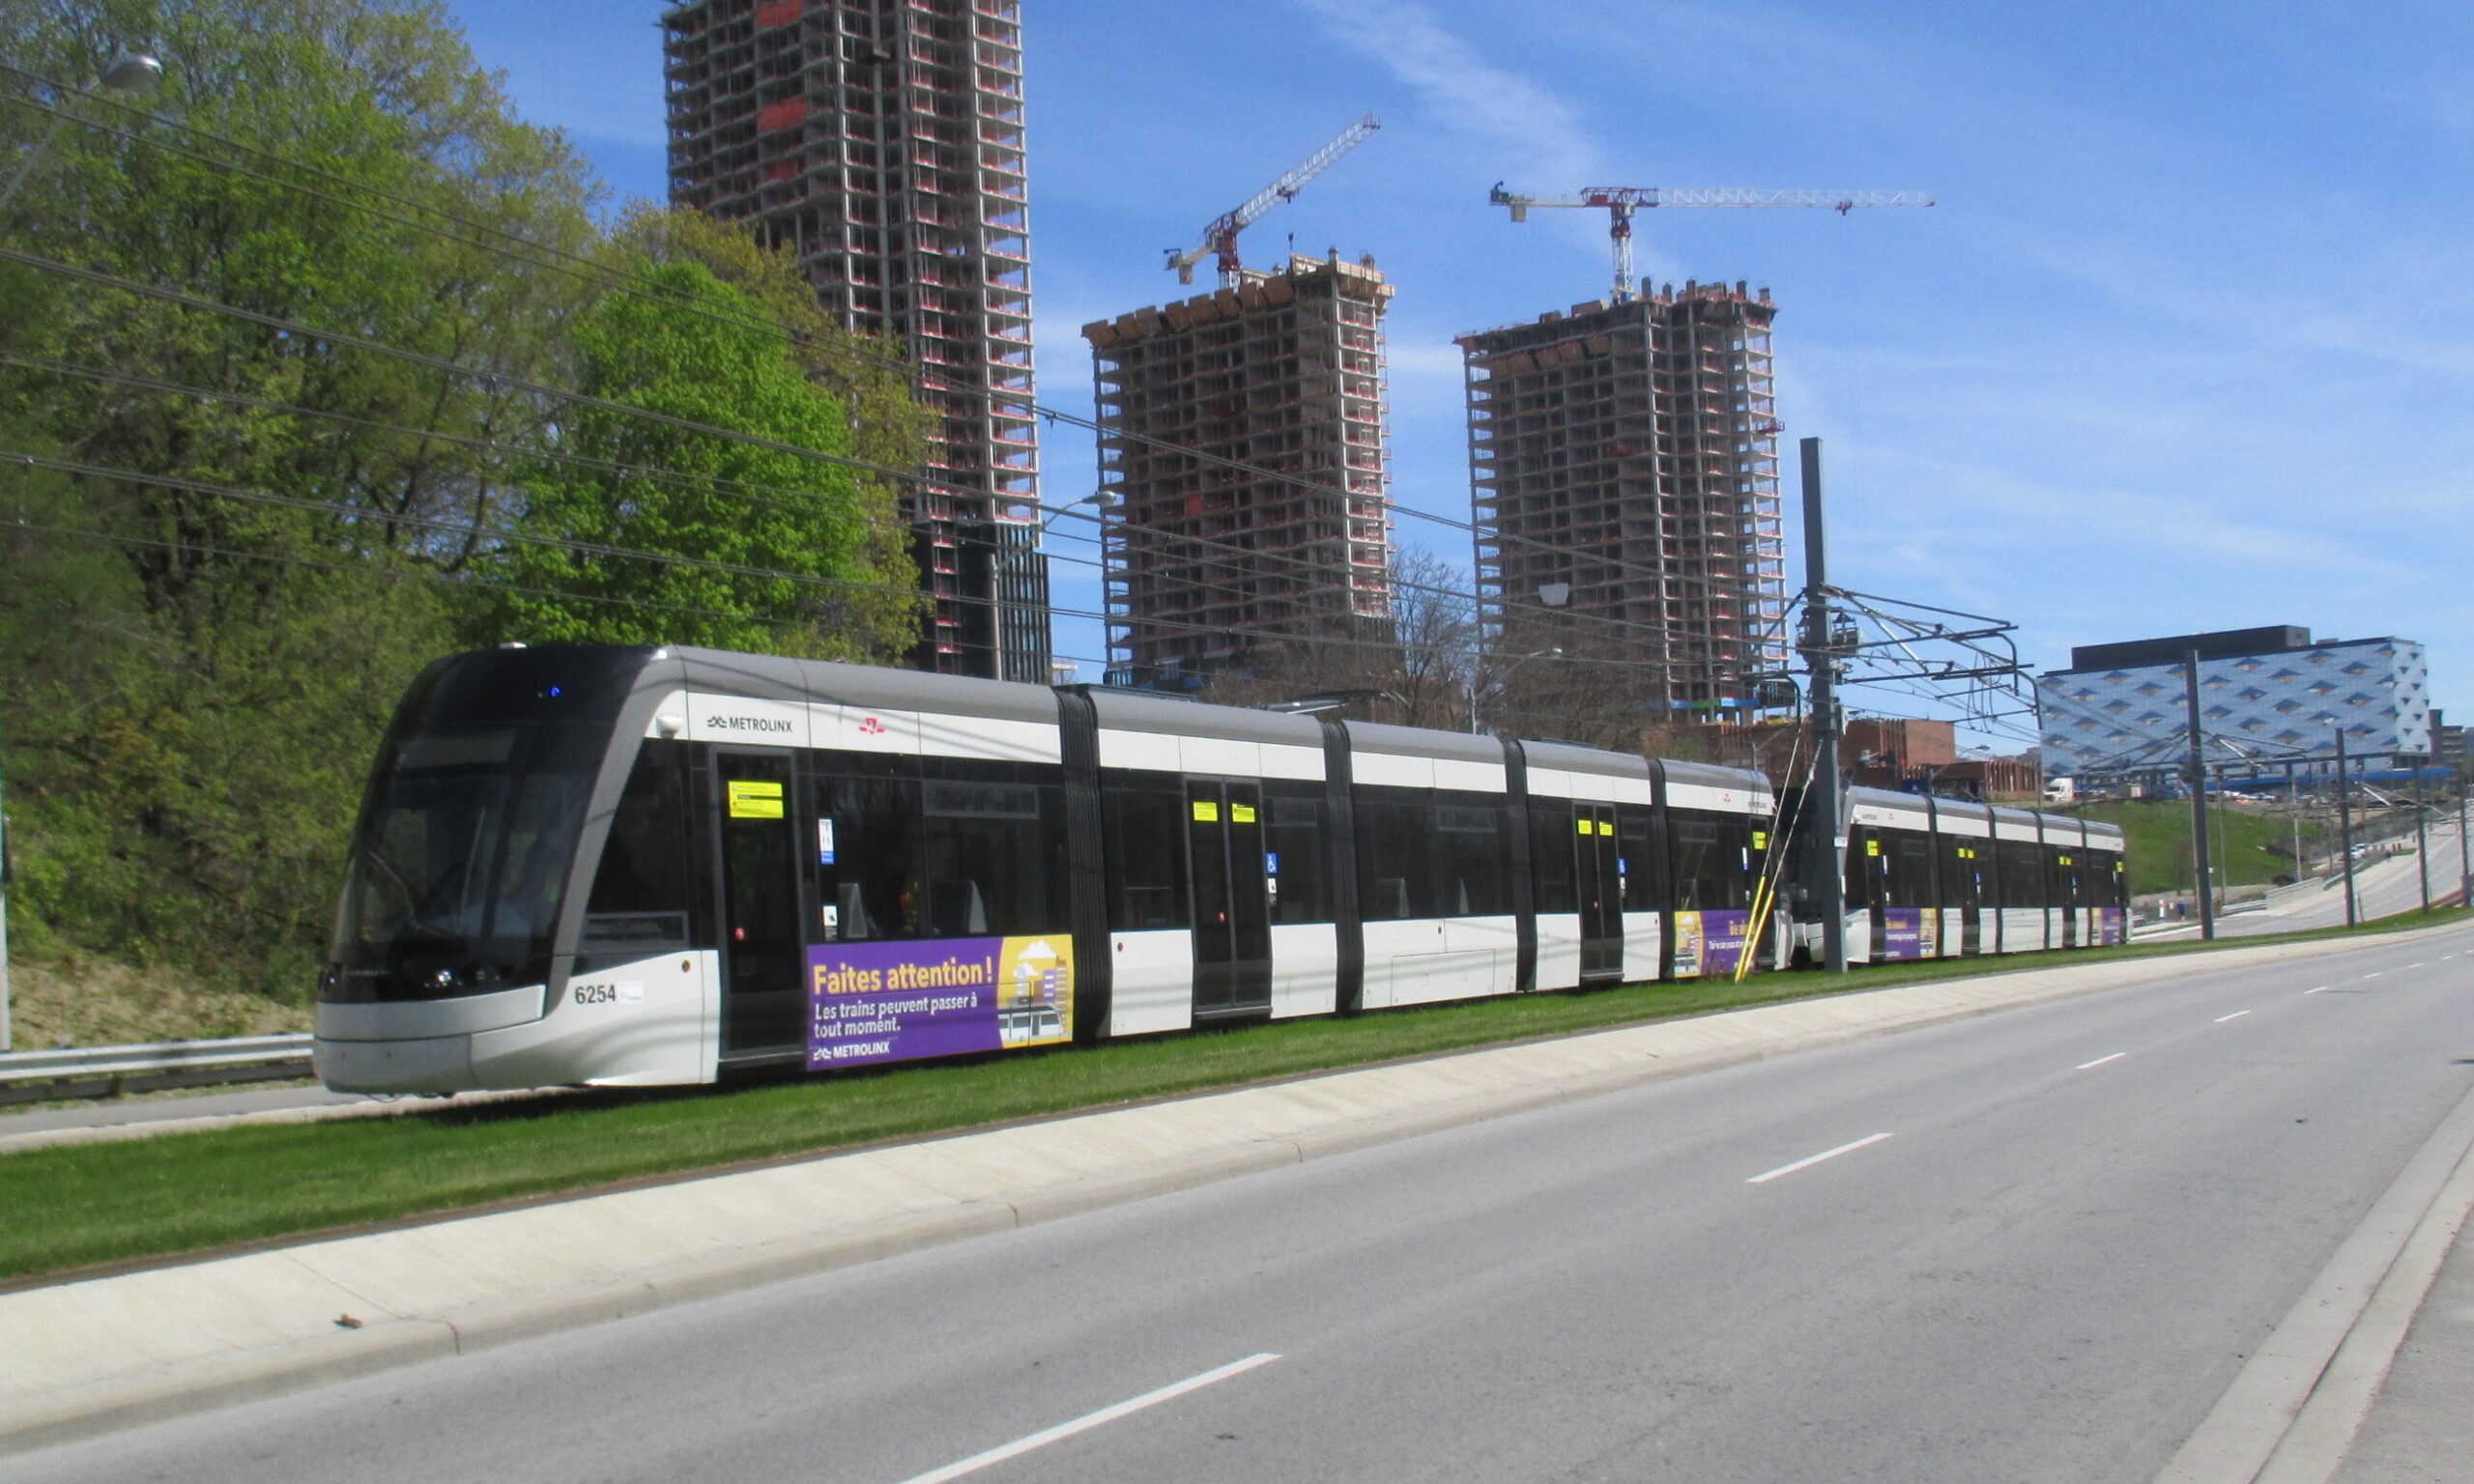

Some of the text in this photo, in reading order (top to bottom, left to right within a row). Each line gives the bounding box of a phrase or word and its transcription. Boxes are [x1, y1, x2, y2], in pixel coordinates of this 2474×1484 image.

[729, 717, 792, 733] METROLINX
[814, 962, 881, 995] Faites
[575, 984, 616, 1005] 6254
[815, 991, 978, 1020] Les trains peuvent passer à
[814, 1017, 901, 1039] tout moment.
[833, 1041, 890, 1058] METROLINX
